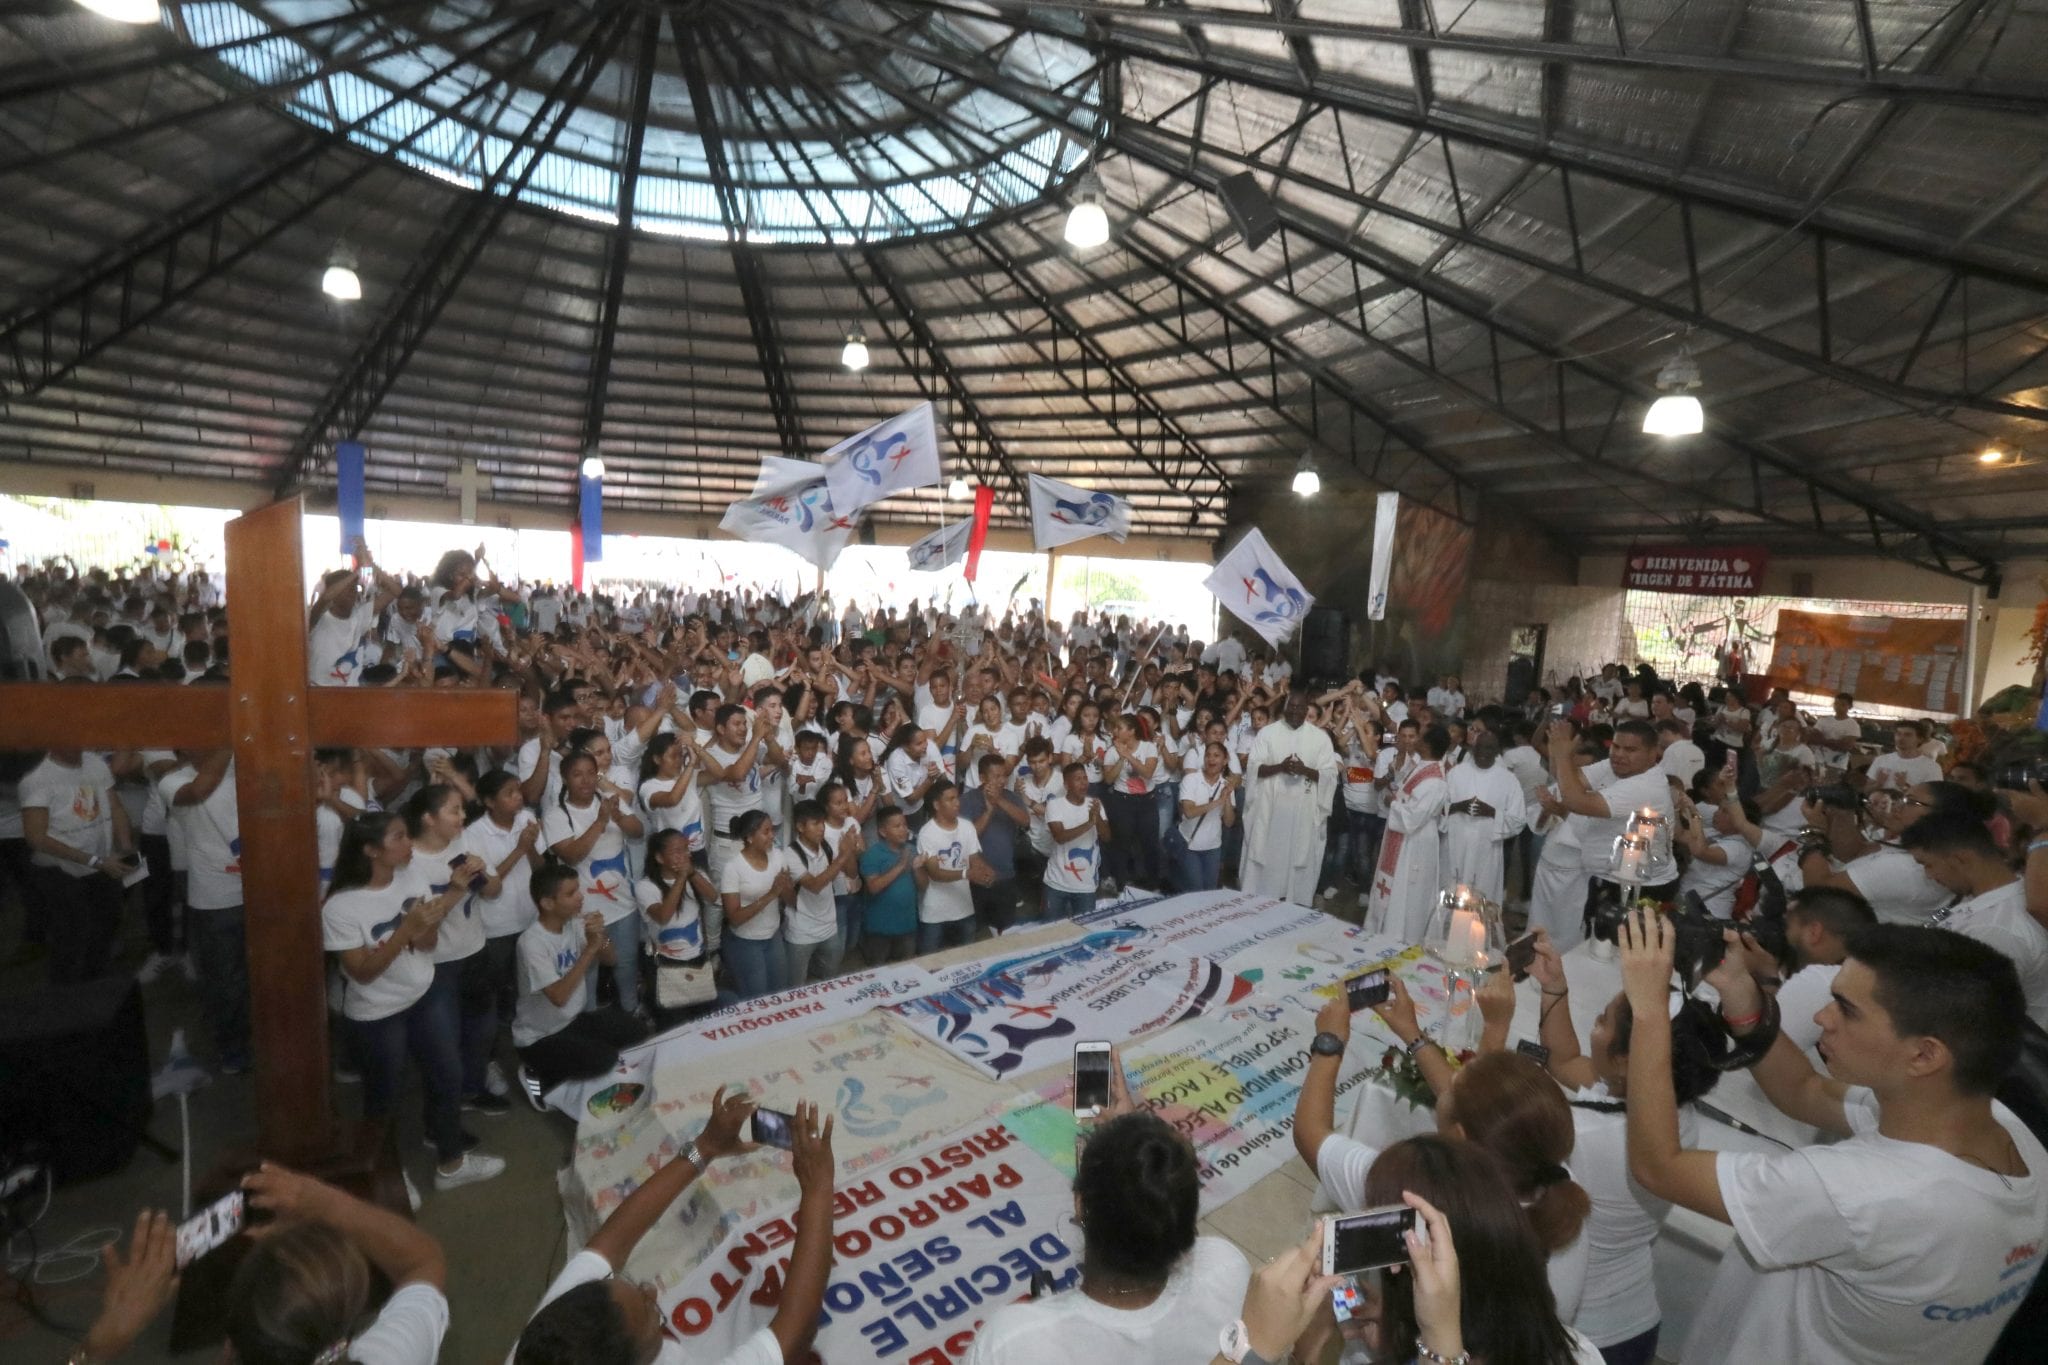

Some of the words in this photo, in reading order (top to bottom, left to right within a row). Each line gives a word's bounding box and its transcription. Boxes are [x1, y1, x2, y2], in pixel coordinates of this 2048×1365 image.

[1629, 573, 1673, 586] VIRGEN
[1677, 575, 1693, 587] DE
[1699, 573, 1754, 588] FÁTIMA
[1646, 557, 1729, 572] BIENVENIDA
[1087, 984, 1132, 1013] LIBRES
[700, 1002, 826, 1042] PARROQUIA
[1198, 1071, 1216, 1085] Y
[1224, 1049, 1312, 1105] COMUNIDAD
[1136, 1079, 1200, 1117] ACOGE
[1171, 1099, 1227, 1136] ALEG
[1237, 1125, 1285, 1157] Reina
[1216, 1152, 1240, 1170] de
[966, 1200, 1026, 1239] AL
[817, 1236, 962, 1330] SEÑO
[860, 1233, 1071, 1358] DECIRLE
